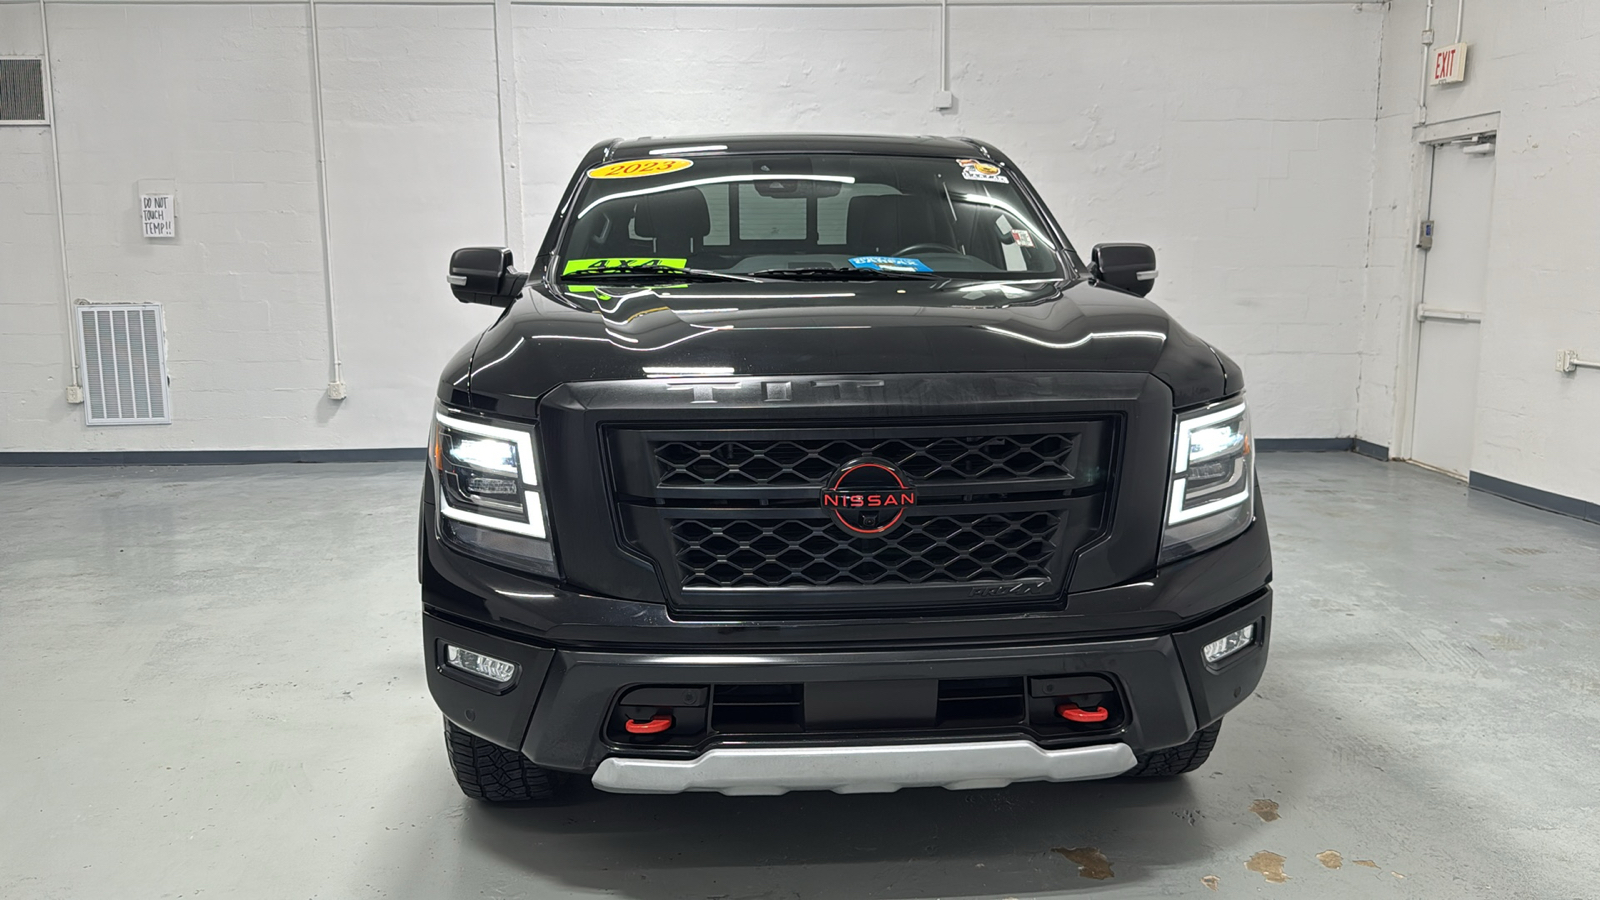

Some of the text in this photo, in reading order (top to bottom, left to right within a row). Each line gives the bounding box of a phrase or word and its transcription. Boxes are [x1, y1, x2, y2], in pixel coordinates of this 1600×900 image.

[1434, 49, 1456, 79] EXIT
[604, 160, 677, 177] 2023
[143, 197, 169, 209] DO NOT
[143, 210, 165, 221] TOUCH
[144, 221, 172, 235] TEMP!!
[823, 493, 915, 507] NISSAN
